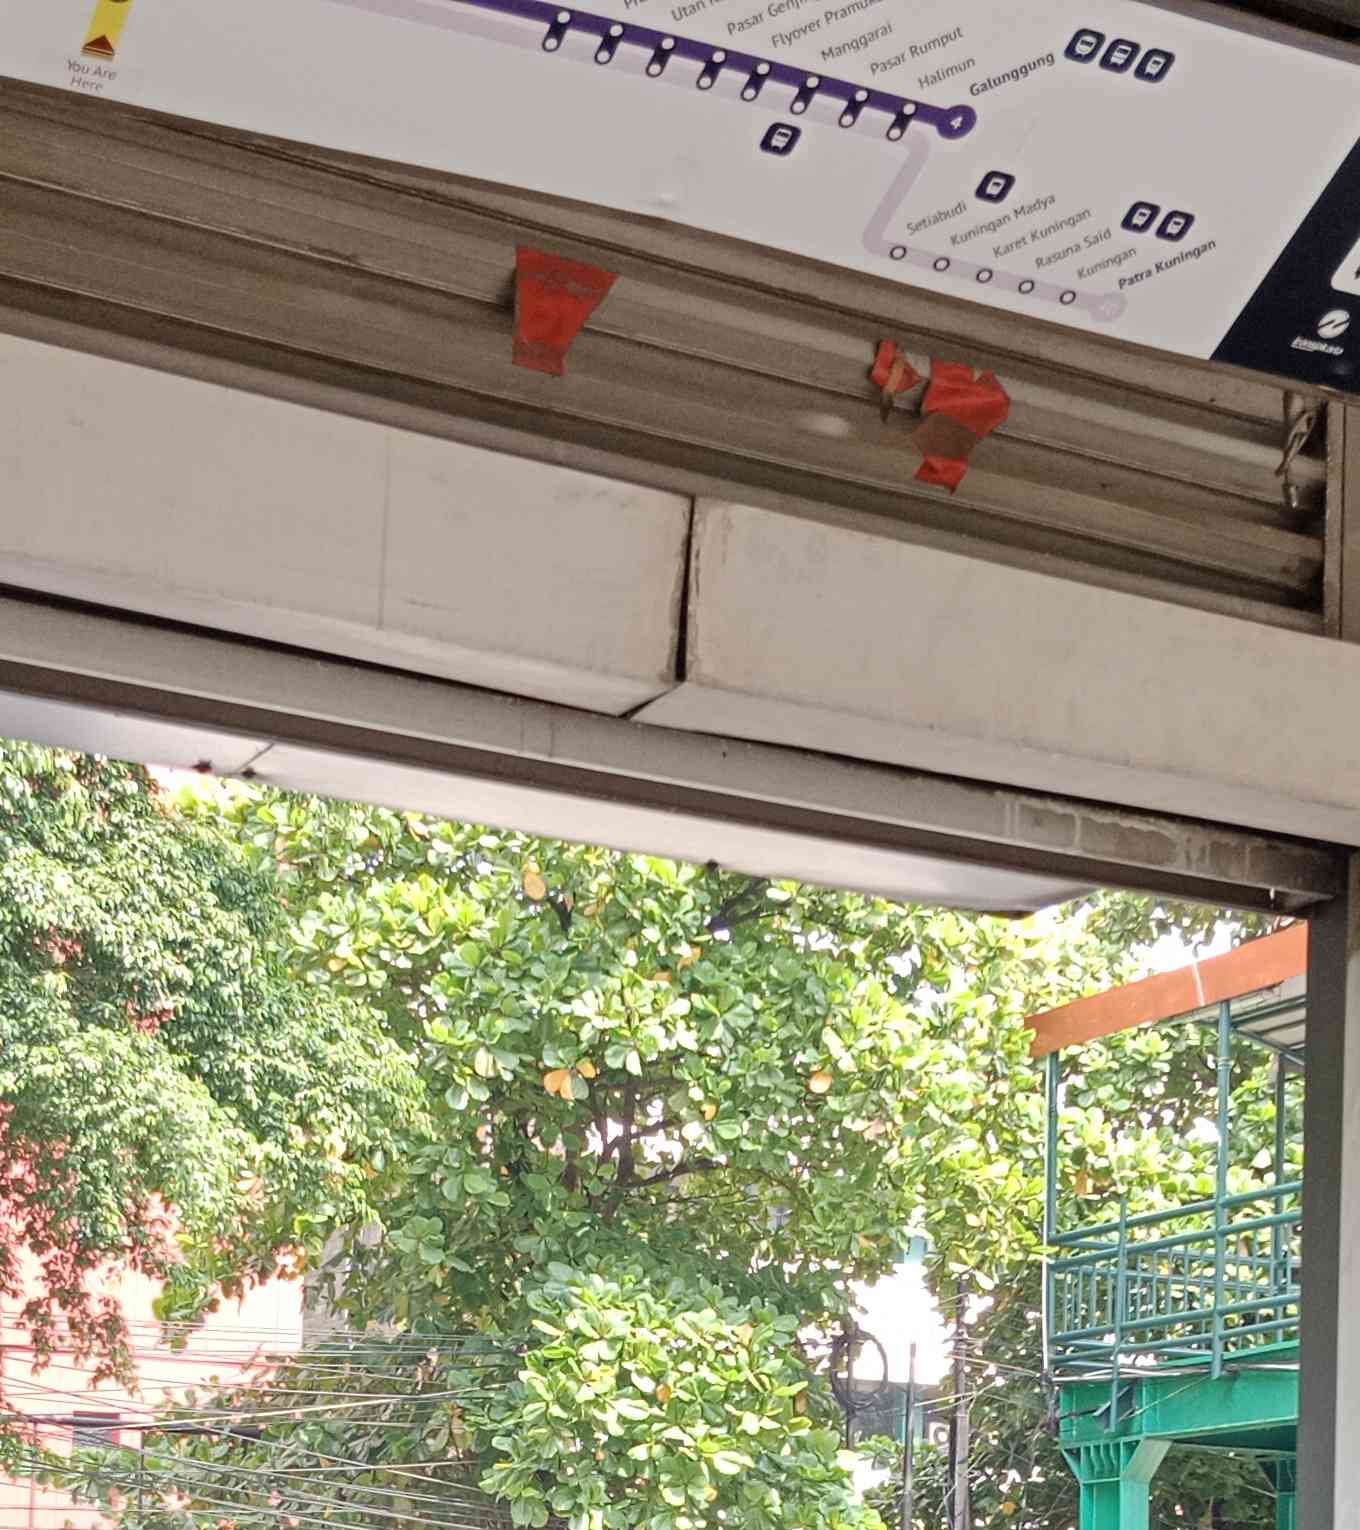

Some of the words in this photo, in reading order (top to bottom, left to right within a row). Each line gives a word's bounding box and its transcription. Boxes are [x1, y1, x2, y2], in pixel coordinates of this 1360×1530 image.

[727, 11, 764, 36] Pasar
[771, 18, 821, 48] Flyover
[821, 21, 893, 62] Manggarai
[870, 52, 906, 75] Pasar
[909, 27, 965, 60] Rumput
[67, 60, 89, 73] You
[92, 66, 117, 80] Are
[70, 77, 103, 91] Here
[917, 56, 976, 90] Halimun
[969, 51, 1056, 97] Galunggung
[950, 115, 963, 130] 4
[950, 213, 1012, 247] Kuningan
[1012, 193, 1057, 222] Madya
[993, 234, 1032, 259] Karet
[1031, 207, 1092, 243] Kuningan
[1076, 246, 1138, 281] Kuningan
[1118, 267, 1154, 290] Patra
[1154, 239, 1218, 274] Kuningan
